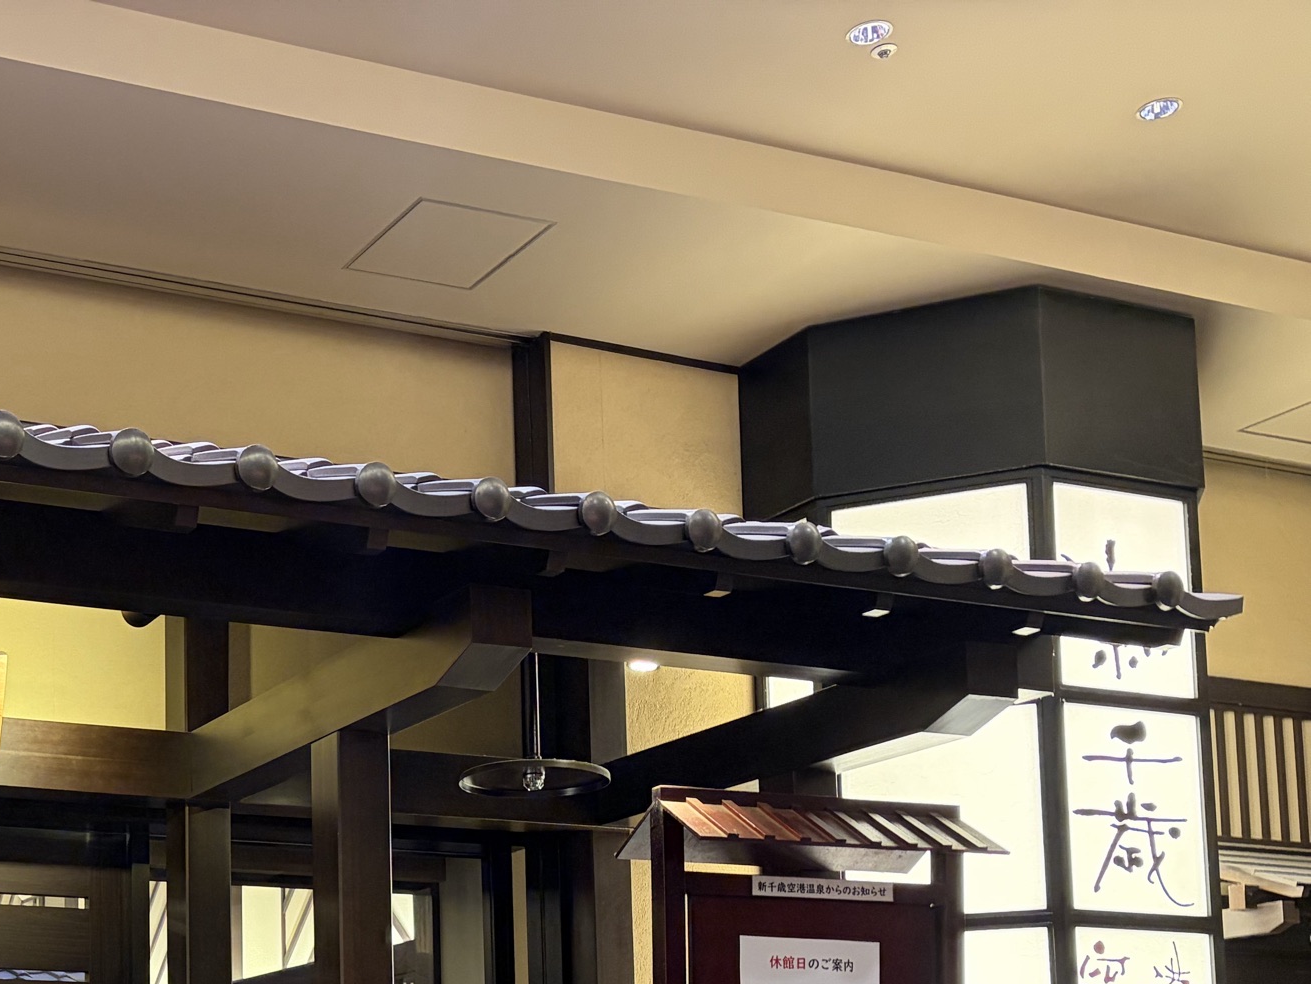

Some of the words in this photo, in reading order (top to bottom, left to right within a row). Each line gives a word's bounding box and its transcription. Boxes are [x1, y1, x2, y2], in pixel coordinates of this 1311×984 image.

[758, 880, 887, 897] 新千歳空港温泉からのお知らせ
[769, 955, 855, 973] 休館日のご案内
